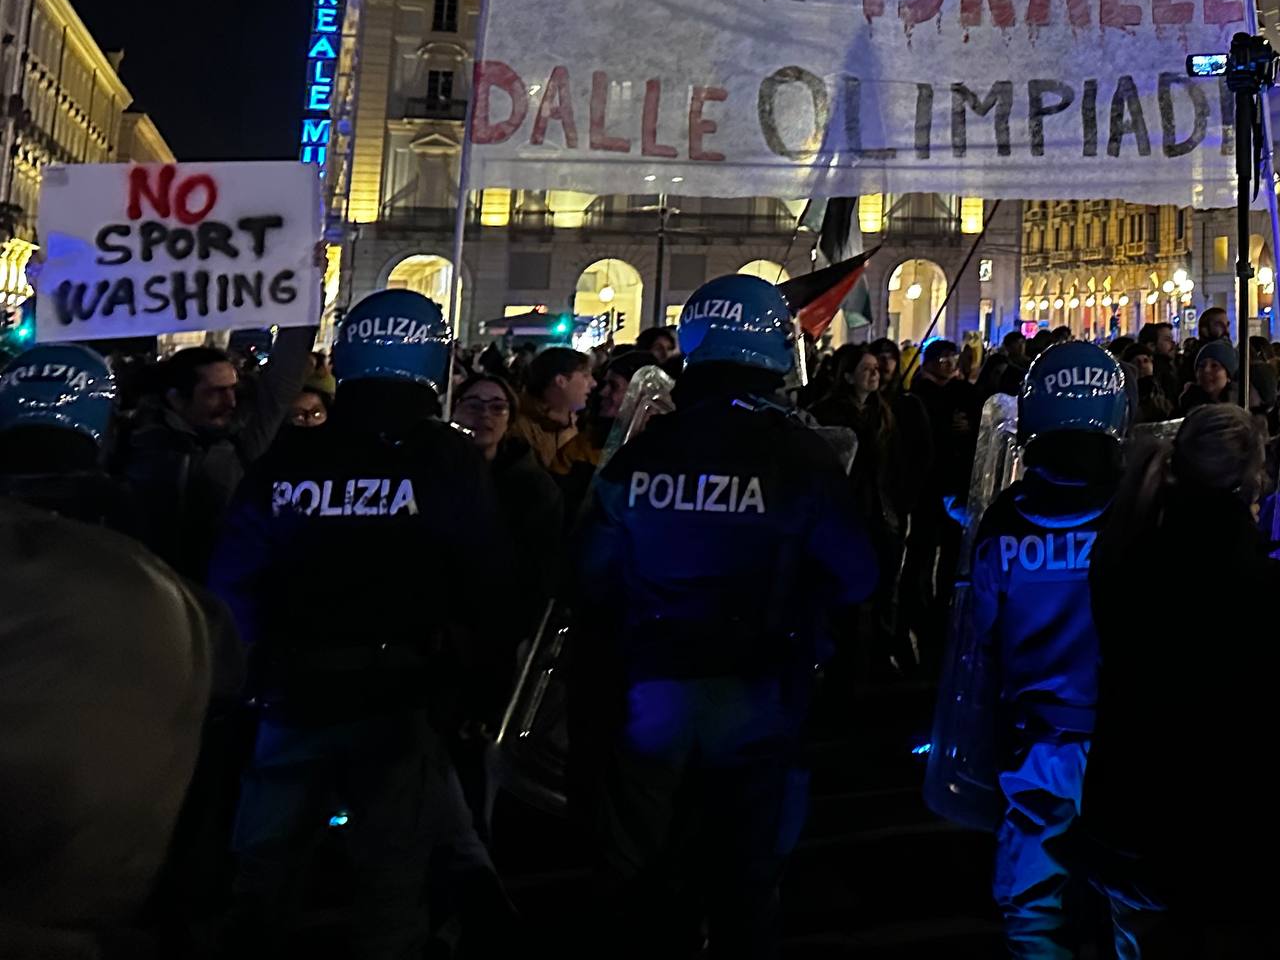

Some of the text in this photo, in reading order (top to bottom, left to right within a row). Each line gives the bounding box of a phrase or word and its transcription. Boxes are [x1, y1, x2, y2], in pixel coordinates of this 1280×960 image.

[470, 60, 729, 162] DALLE
[127, 164, 218, 225] NO
[96, 215, 284, 266] SPORT
[54, 269, 298, 325] WASHING
[347, 316, 430, 344] POLIZIA
[1044, 366, 1119, 394] POLIZIA
[271, 477, 420, 518] POLIZIA
[627, 470, 767, 515] POLIZIA
